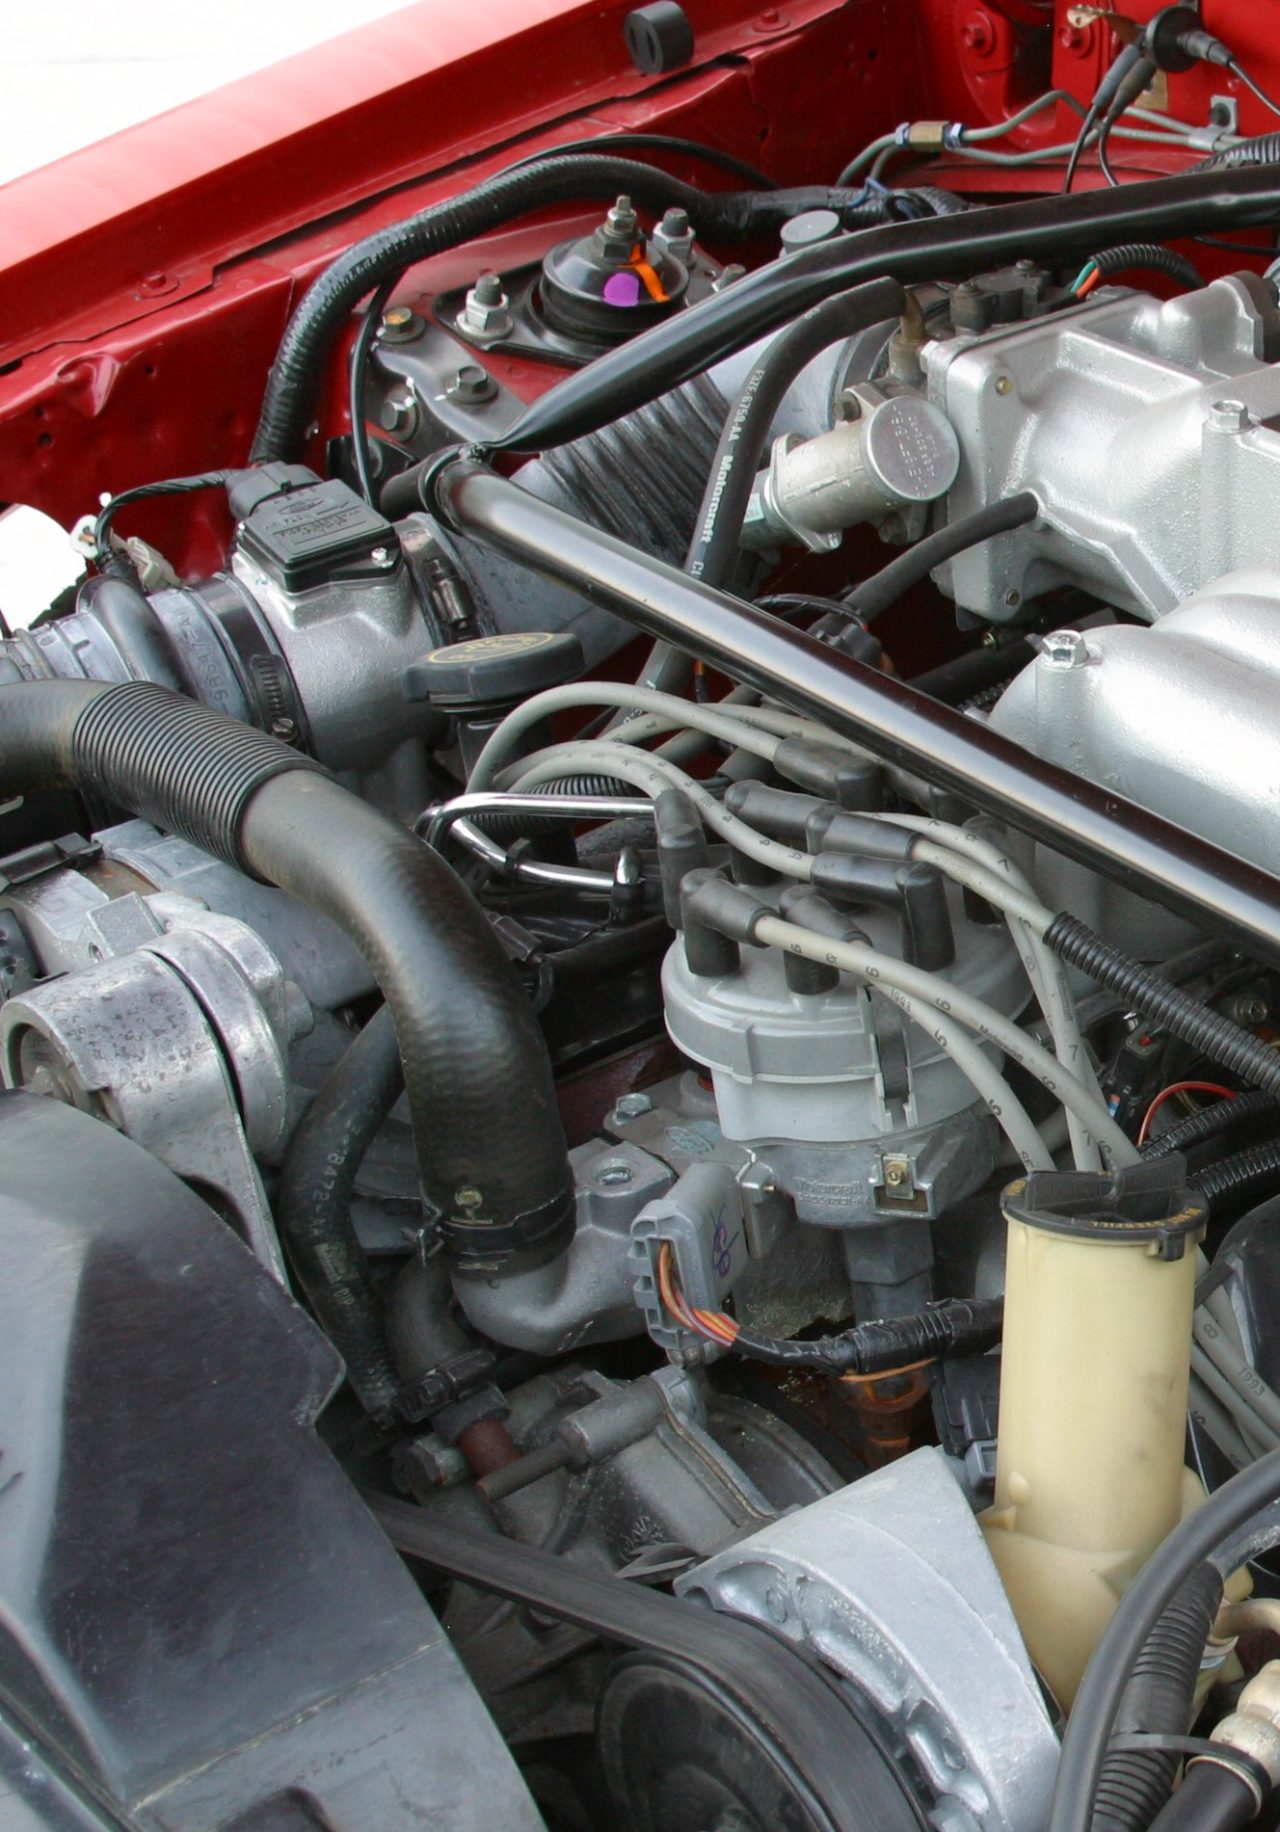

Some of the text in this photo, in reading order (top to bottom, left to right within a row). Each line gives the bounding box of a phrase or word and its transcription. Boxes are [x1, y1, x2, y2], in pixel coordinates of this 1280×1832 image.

[701, 454, 734, 544] Motorcraft
[1068, 1044, 1079, 1062] 7
[1240, 1367, 1267, 1398] 1993
